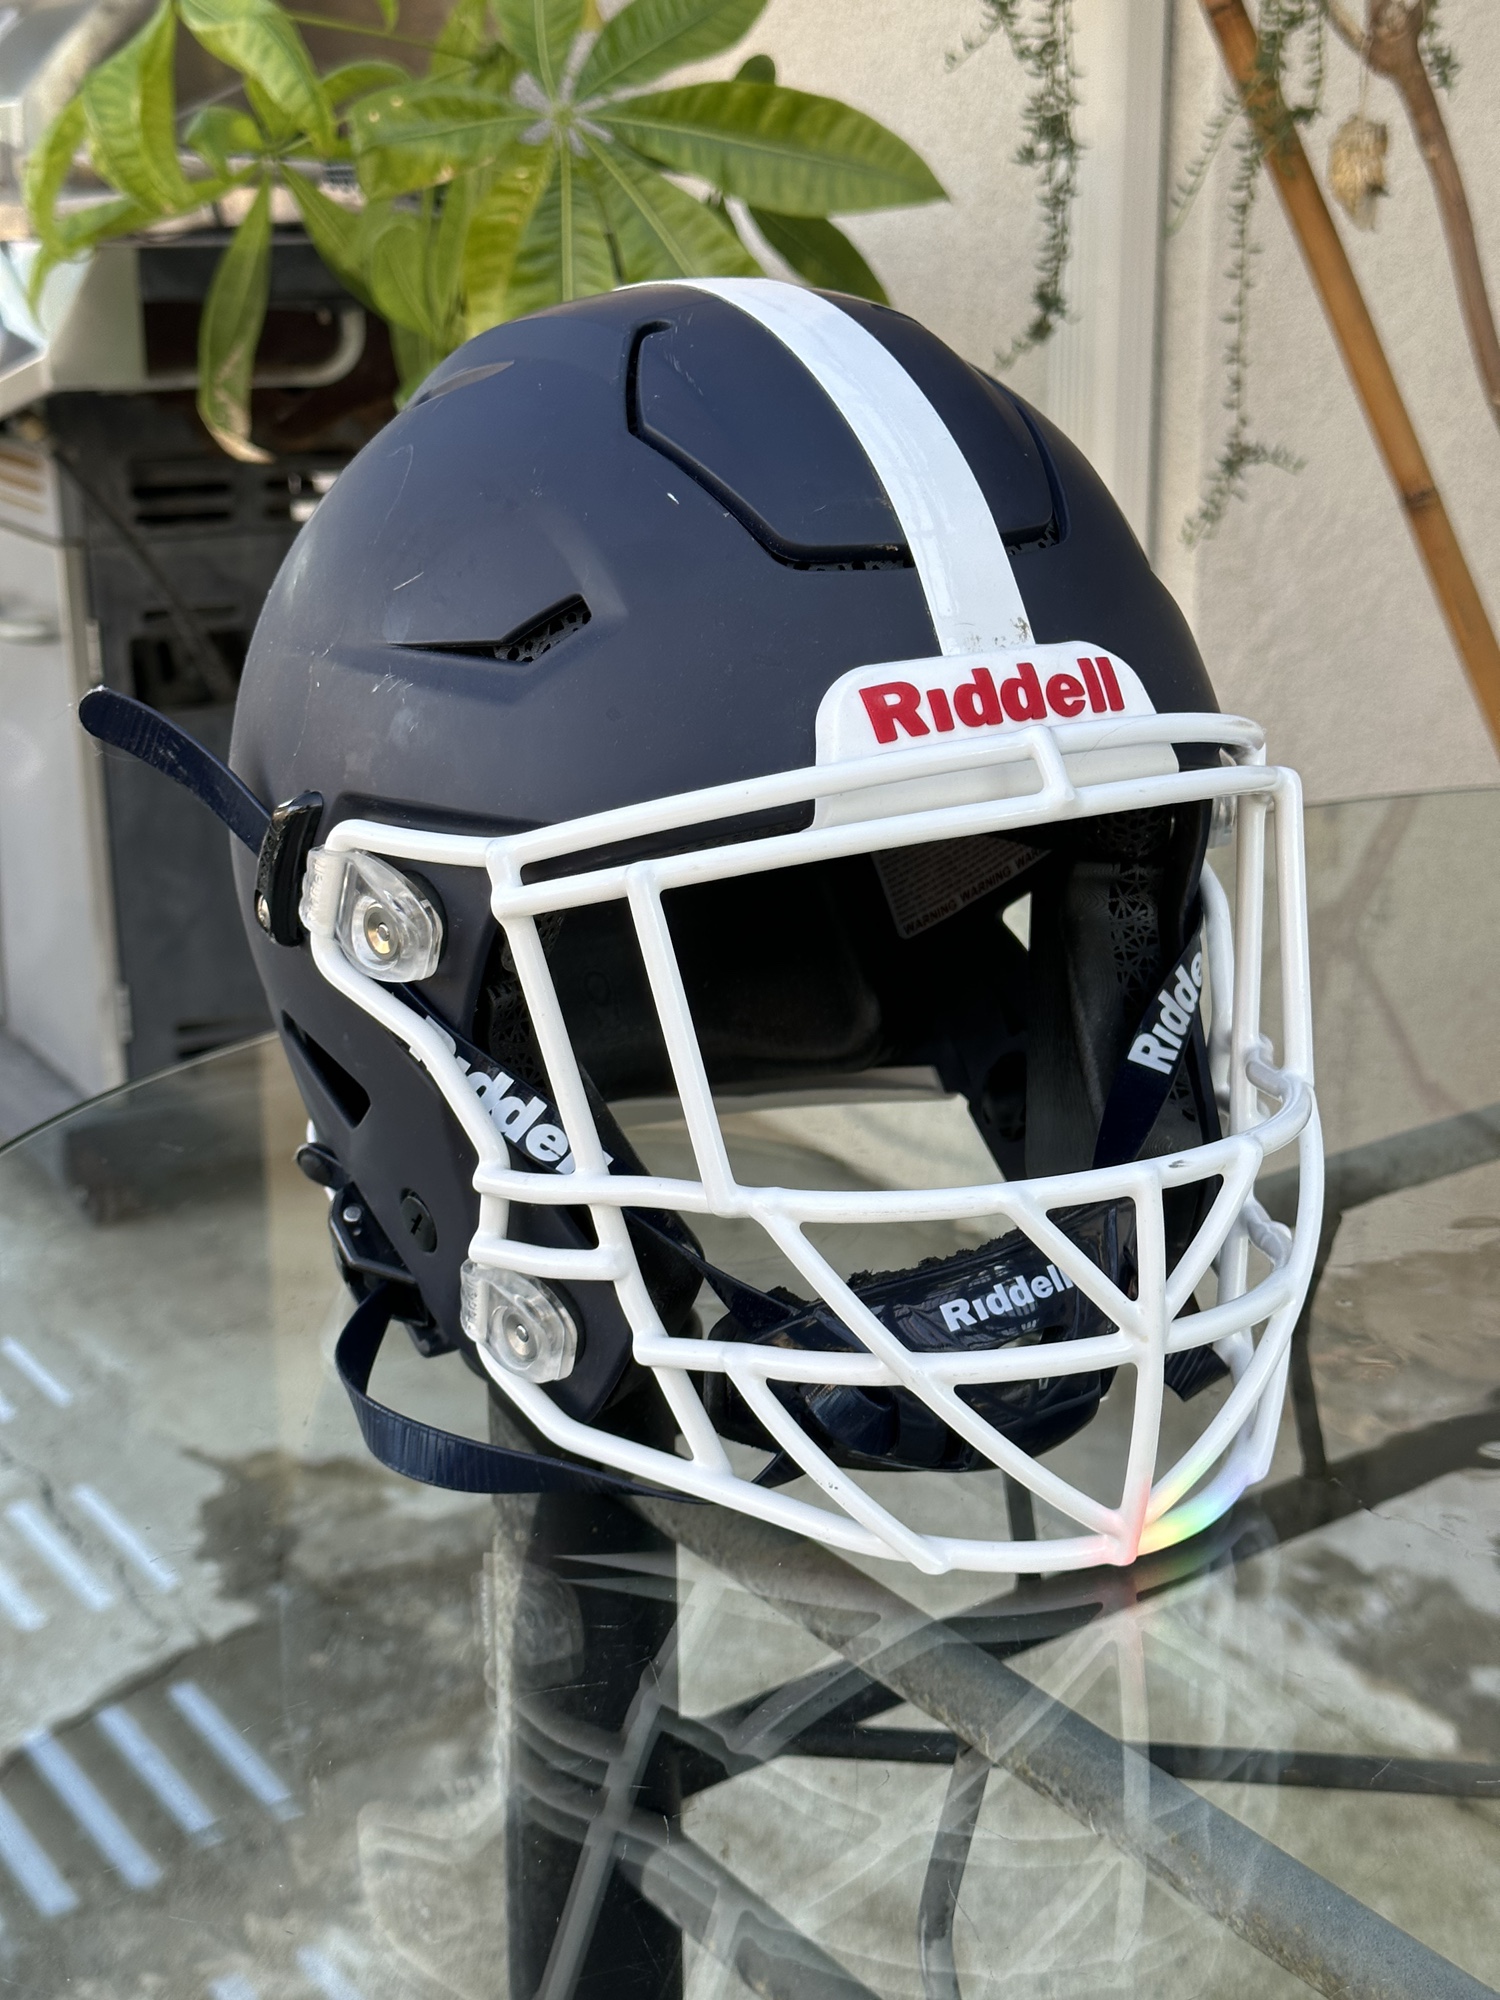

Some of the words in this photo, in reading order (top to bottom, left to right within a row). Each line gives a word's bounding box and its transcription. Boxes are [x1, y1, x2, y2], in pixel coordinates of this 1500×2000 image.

[859, 657, 1125, 744] Riddell
[903, 900, 956, 934] WARNING
[960, 867, 1012, 901] WARNING
[1127, 952, 1202, 1075] Ridde
[939, 1264, 1074, 1332] Riddell
